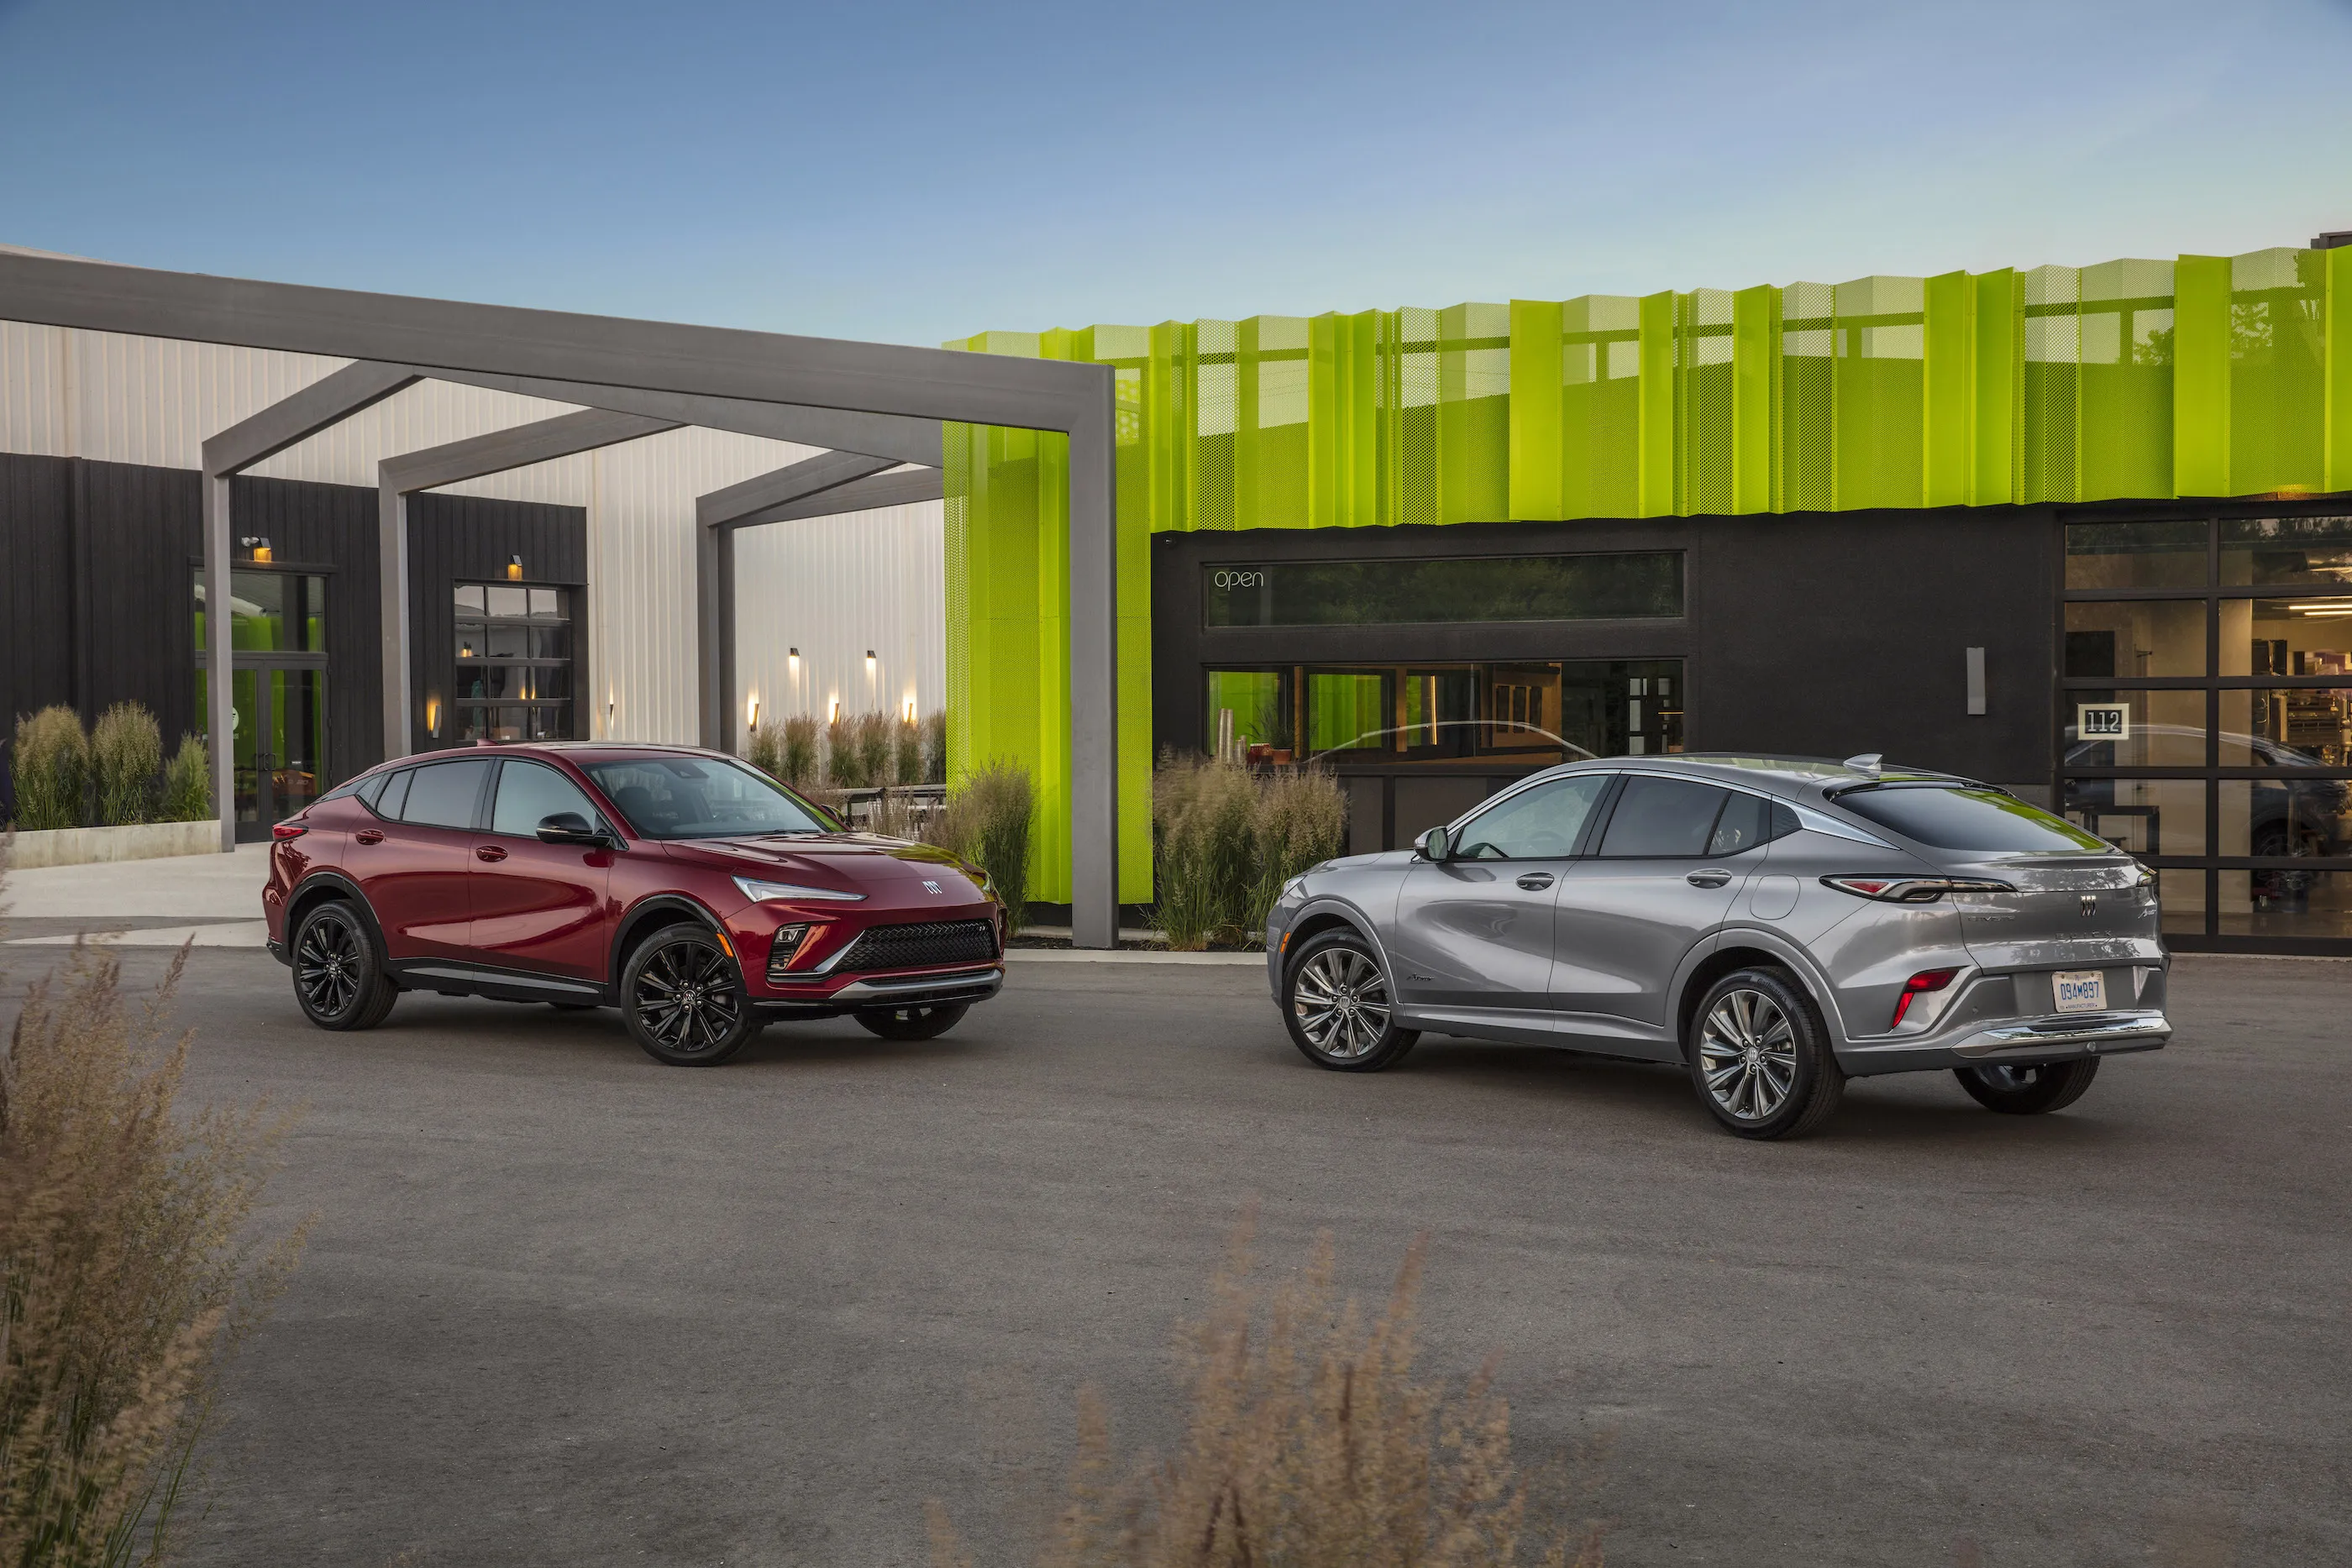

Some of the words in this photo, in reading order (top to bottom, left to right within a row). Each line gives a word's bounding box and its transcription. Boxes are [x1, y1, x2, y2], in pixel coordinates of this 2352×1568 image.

[1215, 571, 1263, 591] open
[2087, 711, 2119, 732] 112
[2060, 981, 2099, 1000] 094M897
